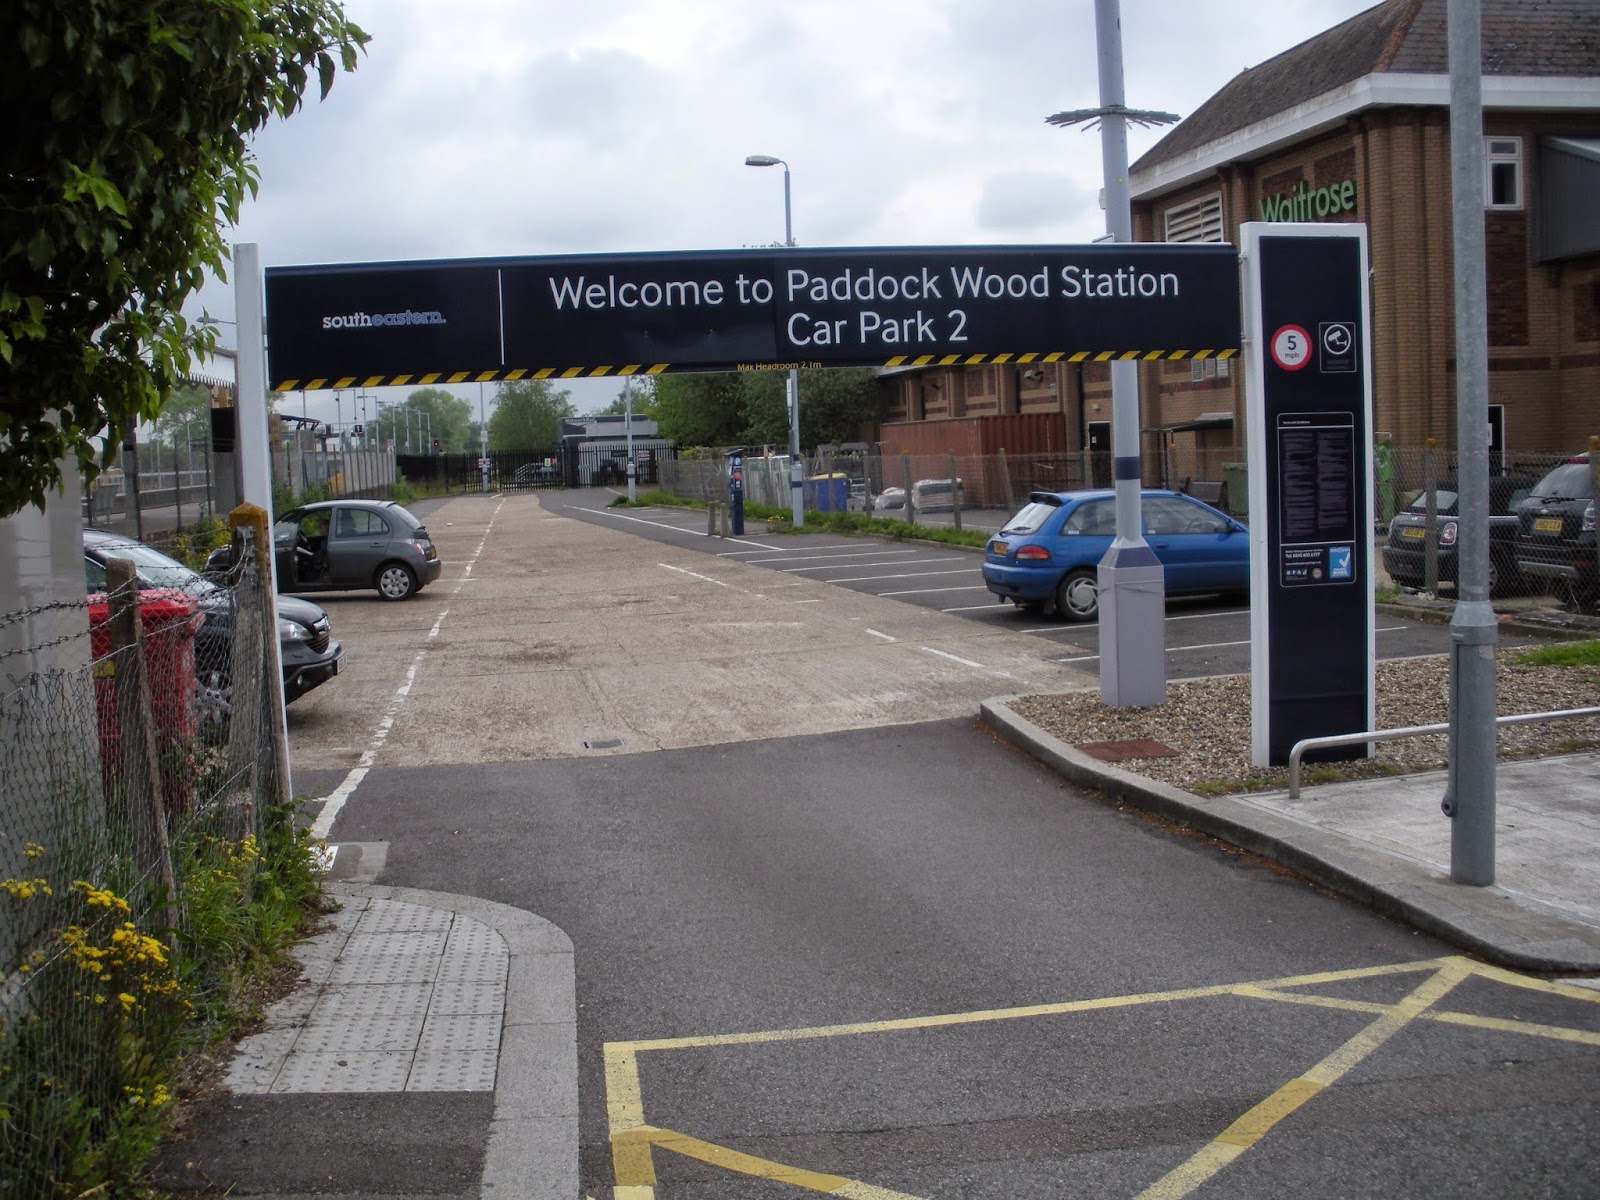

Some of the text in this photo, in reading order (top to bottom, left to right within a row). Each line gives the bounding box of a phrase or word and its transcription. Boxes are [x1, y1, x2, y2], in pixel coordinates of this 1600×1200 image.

[1258, 179, 1355, 221] Waitrose
[548, 265, 1179, 310] Welcome to Paddock Wood Station
[787, 310, 968, 345] Car Park 2
[1284, 351, 1300, 359] mph
[1286, 335, 1298, 351] 5
[737, 361, 822, 371] Max Headroom 2.1m
